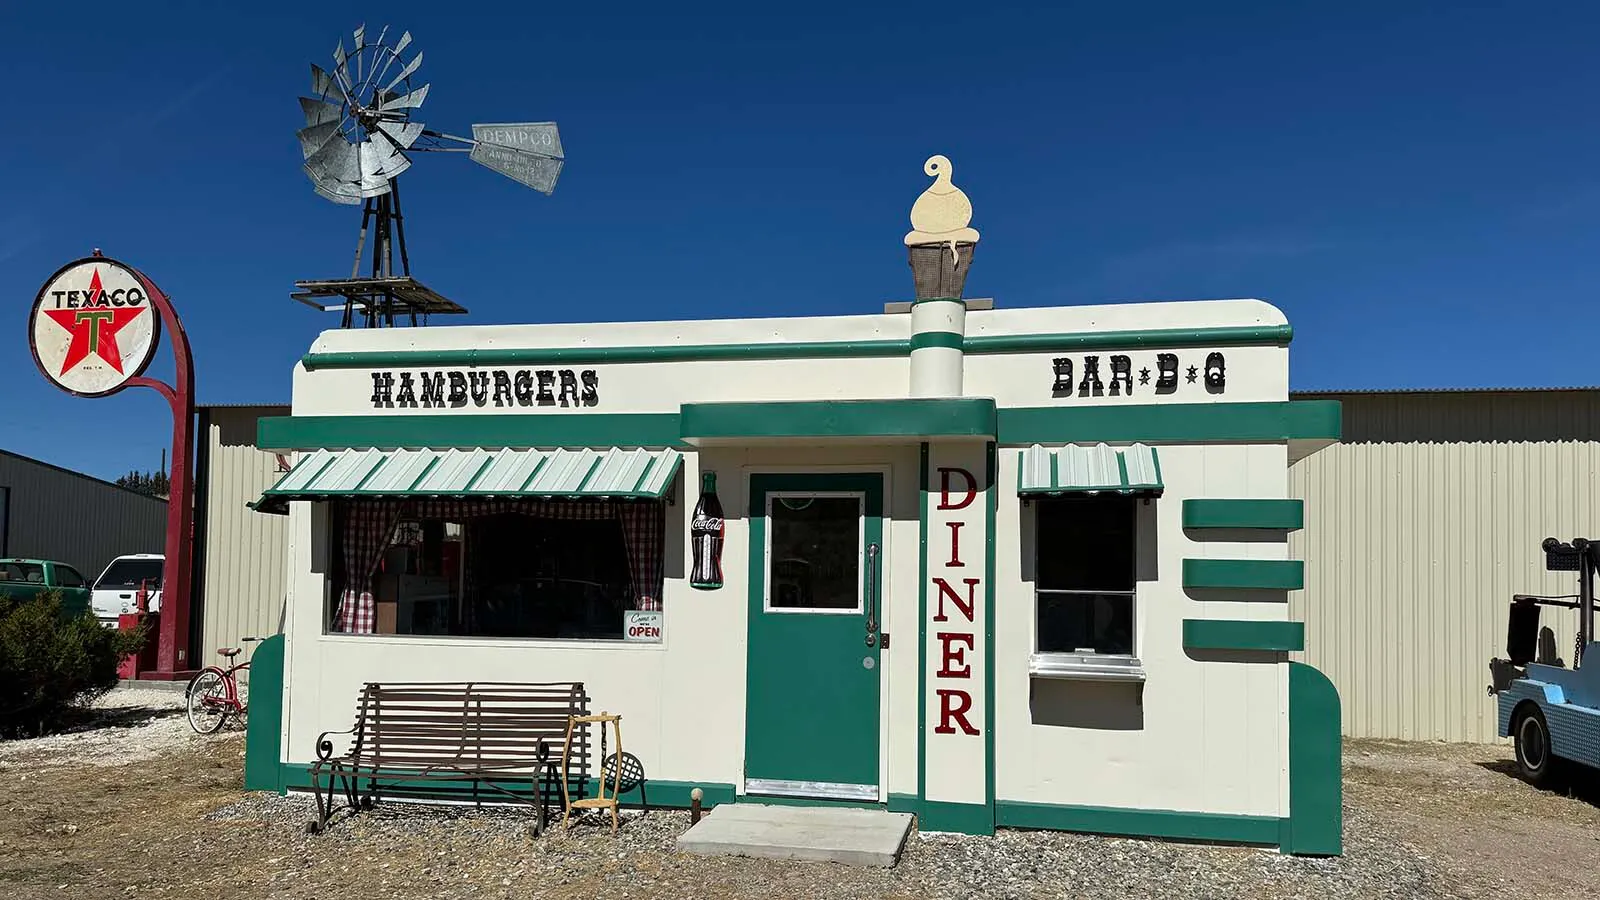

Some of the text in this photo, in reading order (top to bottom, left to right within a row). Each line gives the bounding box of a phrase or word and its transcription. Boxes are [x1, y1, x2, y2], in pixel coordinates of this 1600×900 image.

[483, 130, 552, 146] DEMPCO
[52, 288, 143, 309] TEXACO
[76, 311, 114, 354] T
[370, 369, 599, 409] HAMBURGERS
[691, 517, 722, 531] Coca-Cola
[932, 467, 981, 736] DINER
[628, 626, 660, 637] OPEN
